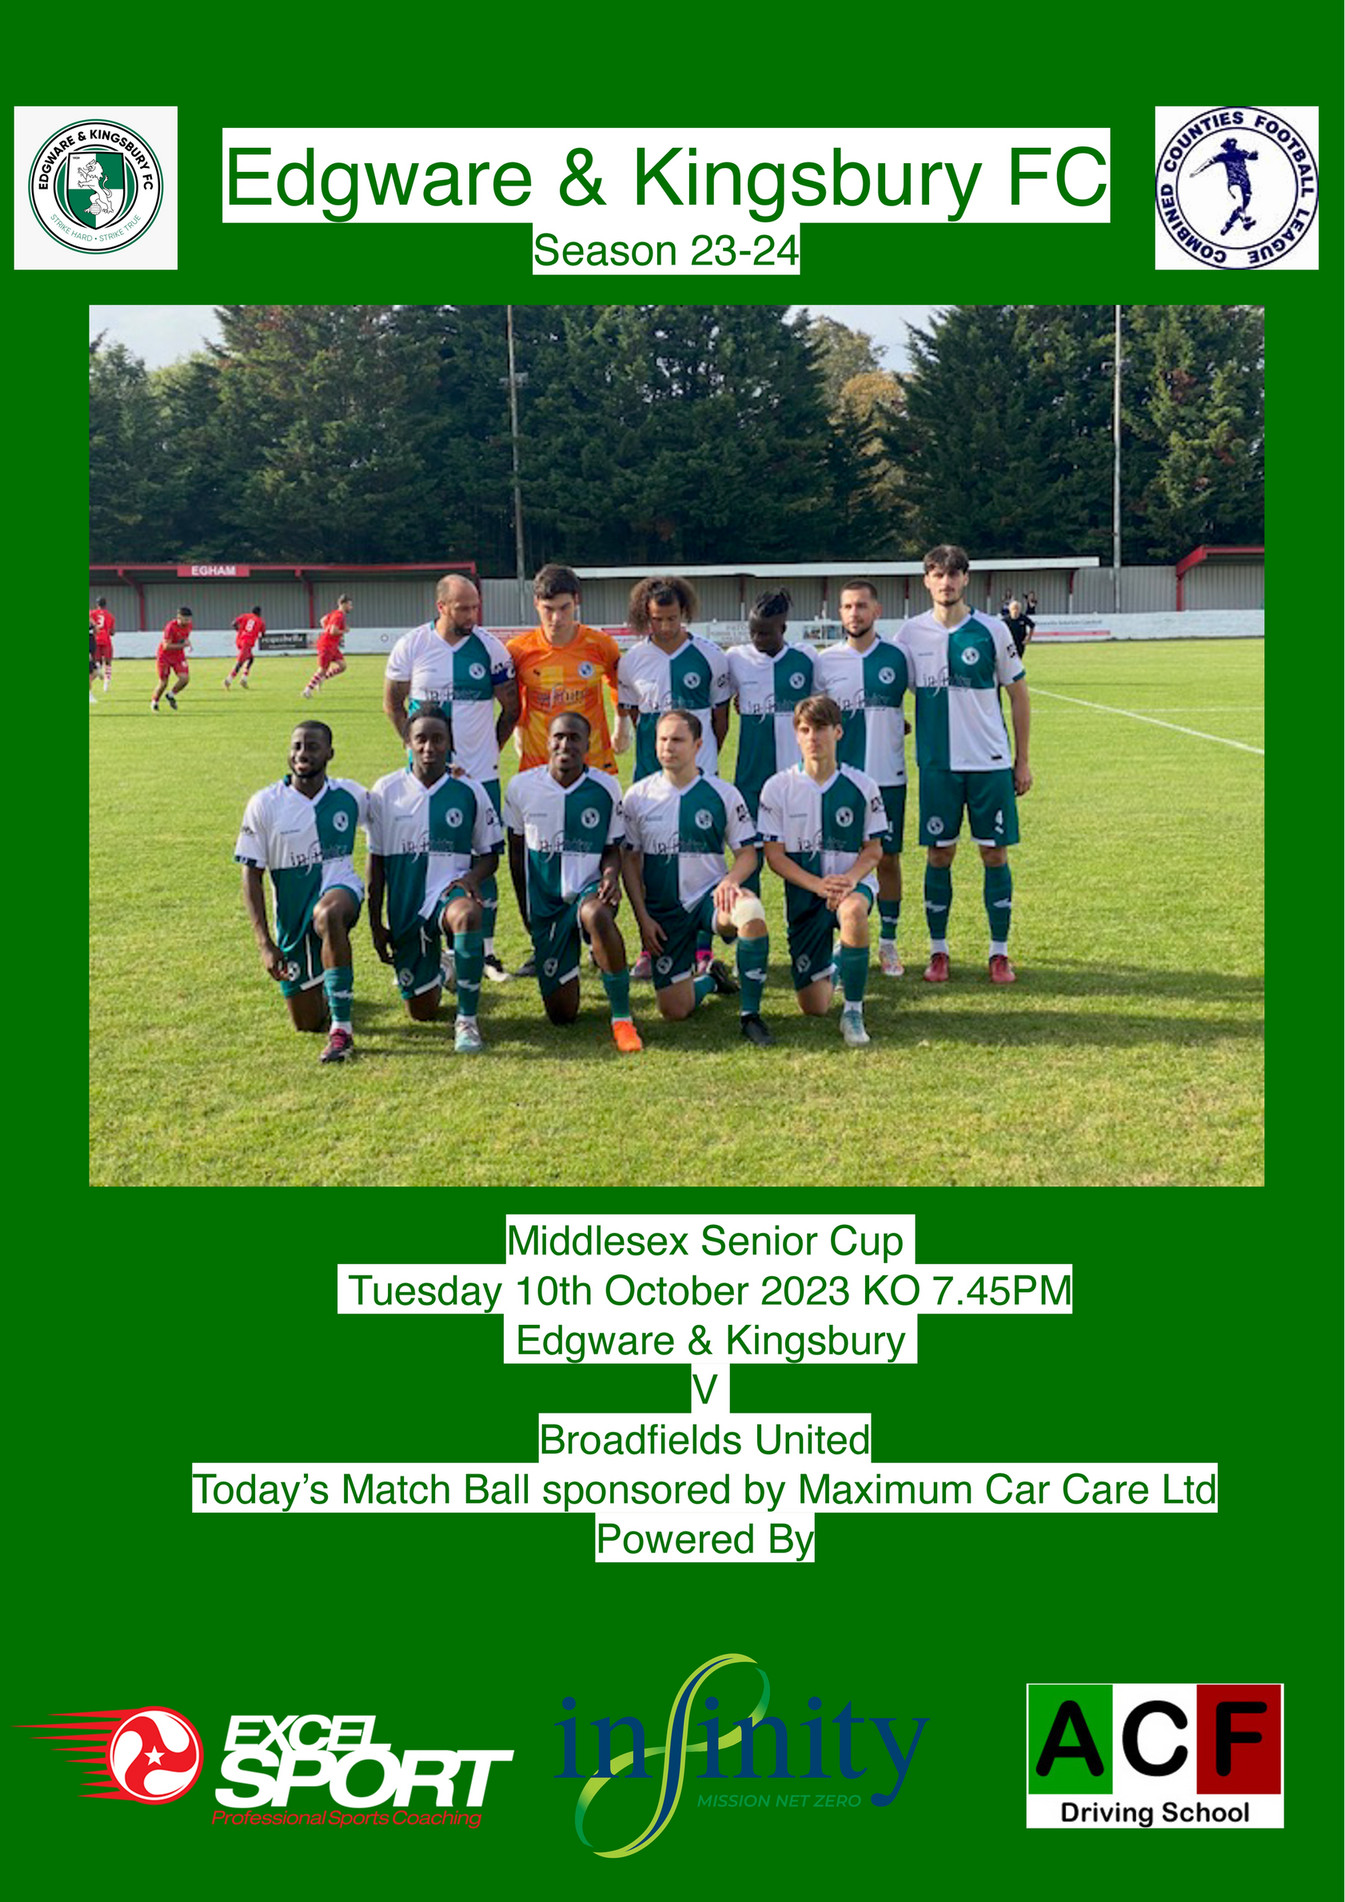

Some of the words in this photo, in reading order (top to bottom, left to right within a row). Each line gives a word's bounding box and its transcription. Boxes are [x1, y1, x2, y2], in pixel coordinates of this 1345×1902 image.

[38, 135, 76, 190] EDGWARE
[77, 131, 87, 142] &
[90, 129, 151, 171] KINGSBURY
[142, 174, 154, 190] FC
[1163, 111, 1244, 173] COUNTIES
[1254, 115, 1314, 198] FOOTBALL
[229, 148, 531, 221] Edgware
[560, 147, 606, 207] &
[637, 148, 982, 221] Kingsbury
[1011, 146, 1107, 207] FC
[50, 213, 71, 234] STRIKE
[70, 229, 93, 242] HARD
[99, 229, 125, 242] STRIKE
[124, 214, 142, 232] TRUE
[1160, 183, 1227, 264] COMBINED
[1247, 208, 1310, 264] LEAGUE
[536, 233, 675, 267] Season
[692, 235, 798, 267] 23-24
[191, 565, 236, 577] EGHAM
[97, 615, 105, 628] 3
[245, 619, 255, 632] 8
[509, 1225, 688, 1256] Middlesex
[702, 1224, 817, 1256] Senior
[831, 1224, 903, 1262] Cup
[349, 1275, 502, 1311] Tuesday
[518, 1275, 591, 1306] 10th
[606, 1274, 749, 1306] October
[762, 1276, 849, 1306] 2023
[865, 1274, 919, 1306] KO
[933, 1275, 1071, 1306] 7.45PM
[519, 1325, 674, 1361] Edgware
[689, 1325, 712, 1355] &
[728, 1325, 905, 1361] Kingsbury
[693, 1374, 718, 1404] V
[542, 1424, 741, 1455] Broadfields
[757, 1424, 869, 1455] United
[194, 1474, 328, 1510] Today’s
[344, 1474, 449, 1505] Match
[466, 1474, 528, 1505] Ball
[543, 1474, 729, 1510] sponsored
[745, 1474, 785, 1510] by
[800, 1474, 971, 1505] Maximum
[987, 1473, 1050, 1505] Car
[1063, 1473, 1148, 1505] Care
[1164, 1474, 1216, 1505] Ltd
[599, 1523, 753, 1554] Powered
[770, 1523, 813, 1560] By
[224, 1714, 392, 1752] EXCEL
[1036, 1700, 1268, 1777] ACF
[553, 1653, 931, 1858] infinity
[215, 1749, 515, 1809] SPORT
[212, 1810, 327, 1825] Professional
[328, 1810, 390, 1829] Sports
[393, 1810, 482, 1829] Coaching
[697, 1794, 771, 1808] MISSION
[775, 1794, 811, 1808] NET
[813, 1794, 862, 1808] ZERO
[1061, 1801, 1154, 1828] Driving
[1162, 1801, 1250, 1823] School
